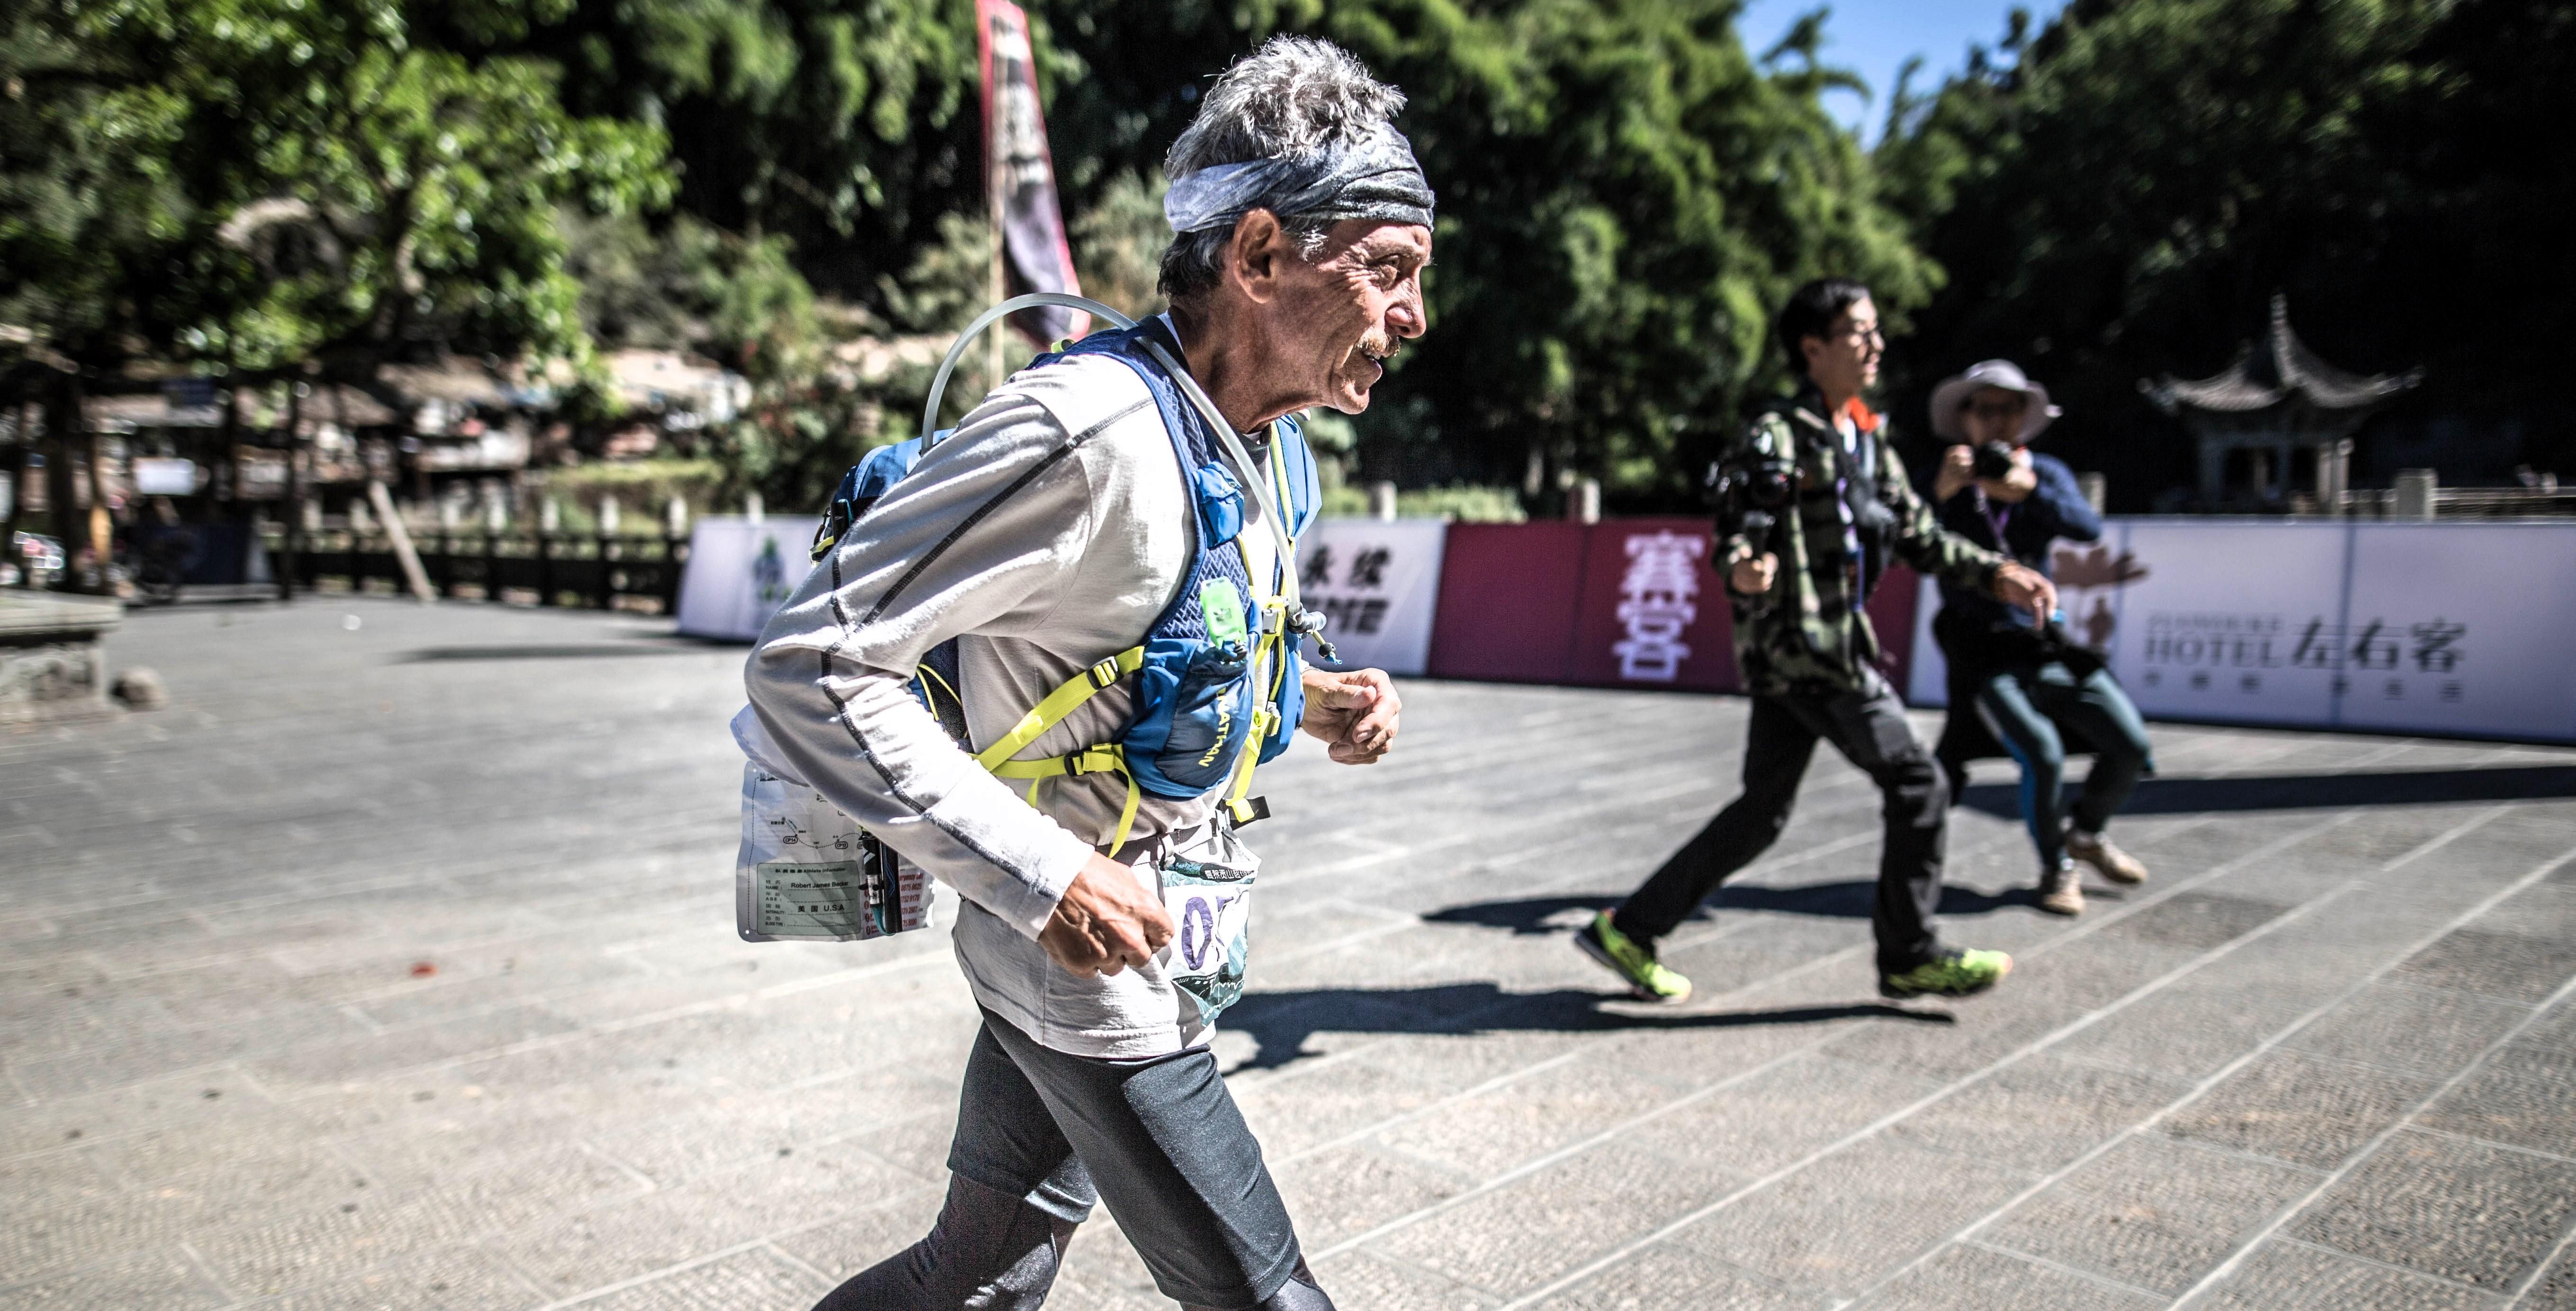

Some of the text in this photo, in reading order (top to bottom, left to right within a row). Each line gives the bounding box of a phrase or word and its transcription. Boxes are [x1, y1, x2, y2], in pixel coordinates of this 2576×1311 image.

[2144, 637, 2280, 668] HOTEL
[2291, 615, 2466, 672] 左右客
